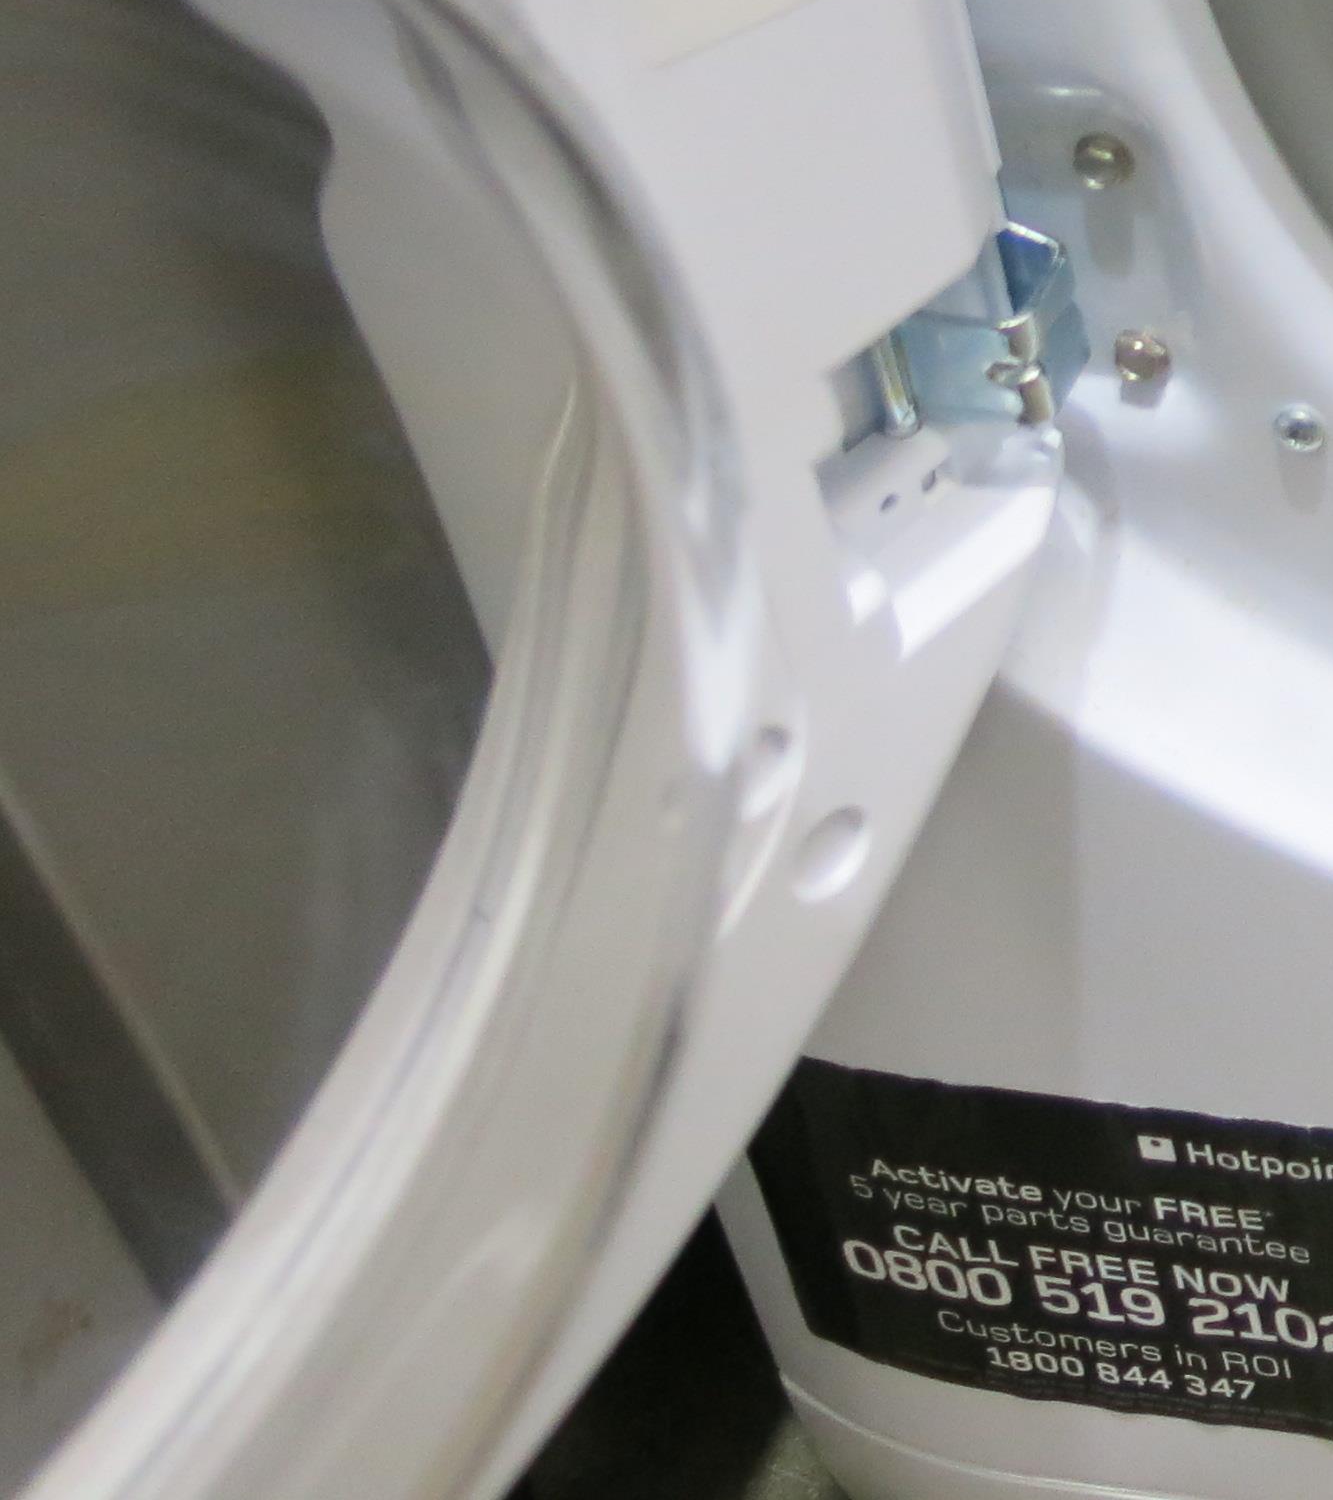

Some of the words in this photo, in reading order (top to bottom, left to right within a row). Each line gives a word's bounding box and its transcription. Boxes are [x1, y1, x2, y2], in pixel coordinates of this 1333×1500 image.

[850, 1174, 873, 1199] 5
[883, 1187, 967, 1217] year
[981, 1204, 1091, 1234] parts
[1103, 1219, 1311, 1264] guarantee
[871, 1159, 1043, 1202] Activate
[1053, 1187, 1141, 1215] your
[842, 1239, 1013, 1306] 0800
[1033, 1274, 1166, 1327] 519
[893, 1224, 1020, 1267] CALL
[1028, 1245, 1160, 1286] FREE
[1172, 1264, 1290, 1302] NOW
[937, 1310, 1162, 1363] Customers
[1173, 1344, 1208, 1371] in
[1221, 1351, 1292, 1380] ROI
[986, 1346, 1086, 1378] 1800
[1095, 1362, 1173, 1390] 844
[1183, 1374, 1256, 1401] 347
